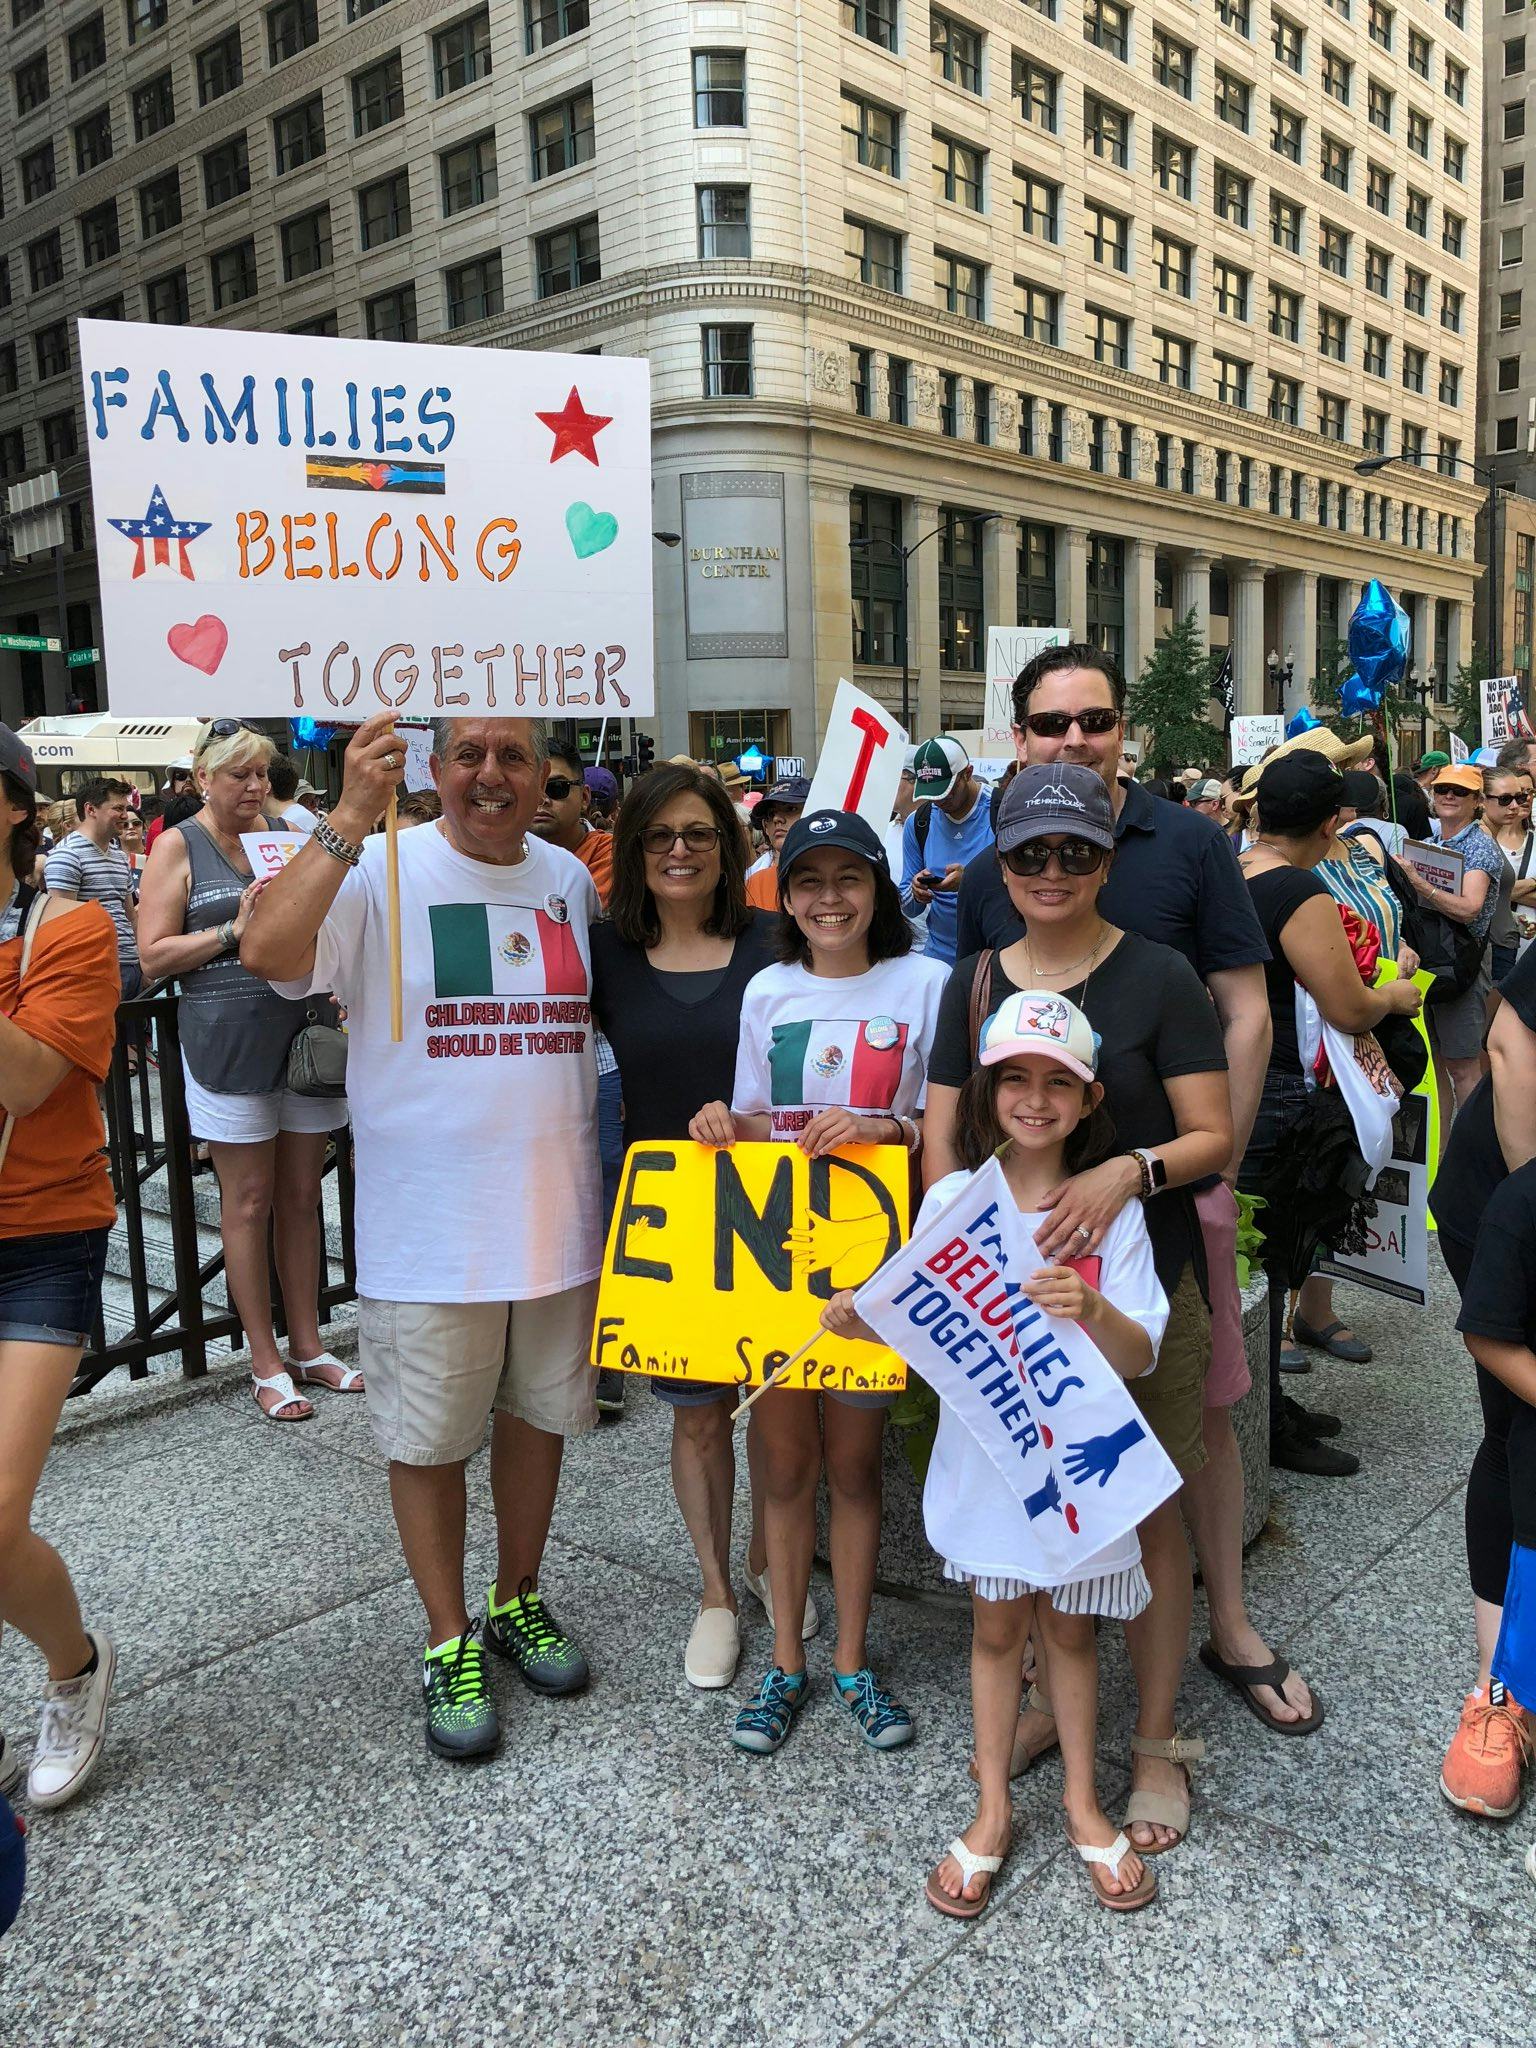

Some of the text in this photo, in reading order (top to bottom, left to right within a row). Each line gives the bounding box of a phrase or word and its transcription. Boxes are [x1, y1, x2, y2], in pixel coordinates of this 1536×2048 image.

[91, 367, 455, 454] FAMILIES
[236, 510, 522, 582] BELONG
[690, 546, 780, 561] BURNHAM
[701, 564, 770, 579] CENTER
[7, 636, 41, 649] Washington
[279, 641, 631, 707] TOGETHER
[1487, 681, 1497, 692] NO
[1486, 692, 1496, 702] NO
[779, 758, 801, 777] NO!
[425, 1003, 504, 1028] CHILDREN
[507, 1002, 540, 1025] AND
[427, 1034, 496, 1059] SHOULD
[499, 1033, 523, 1056] BE
[612, 1150, 901, 1301] END
[925, 1236, 1027, 1385] BELON
[596, 1317, 905, 1390] Family Seperation
[890, 1270, 1040, 1459] TOGETHER
